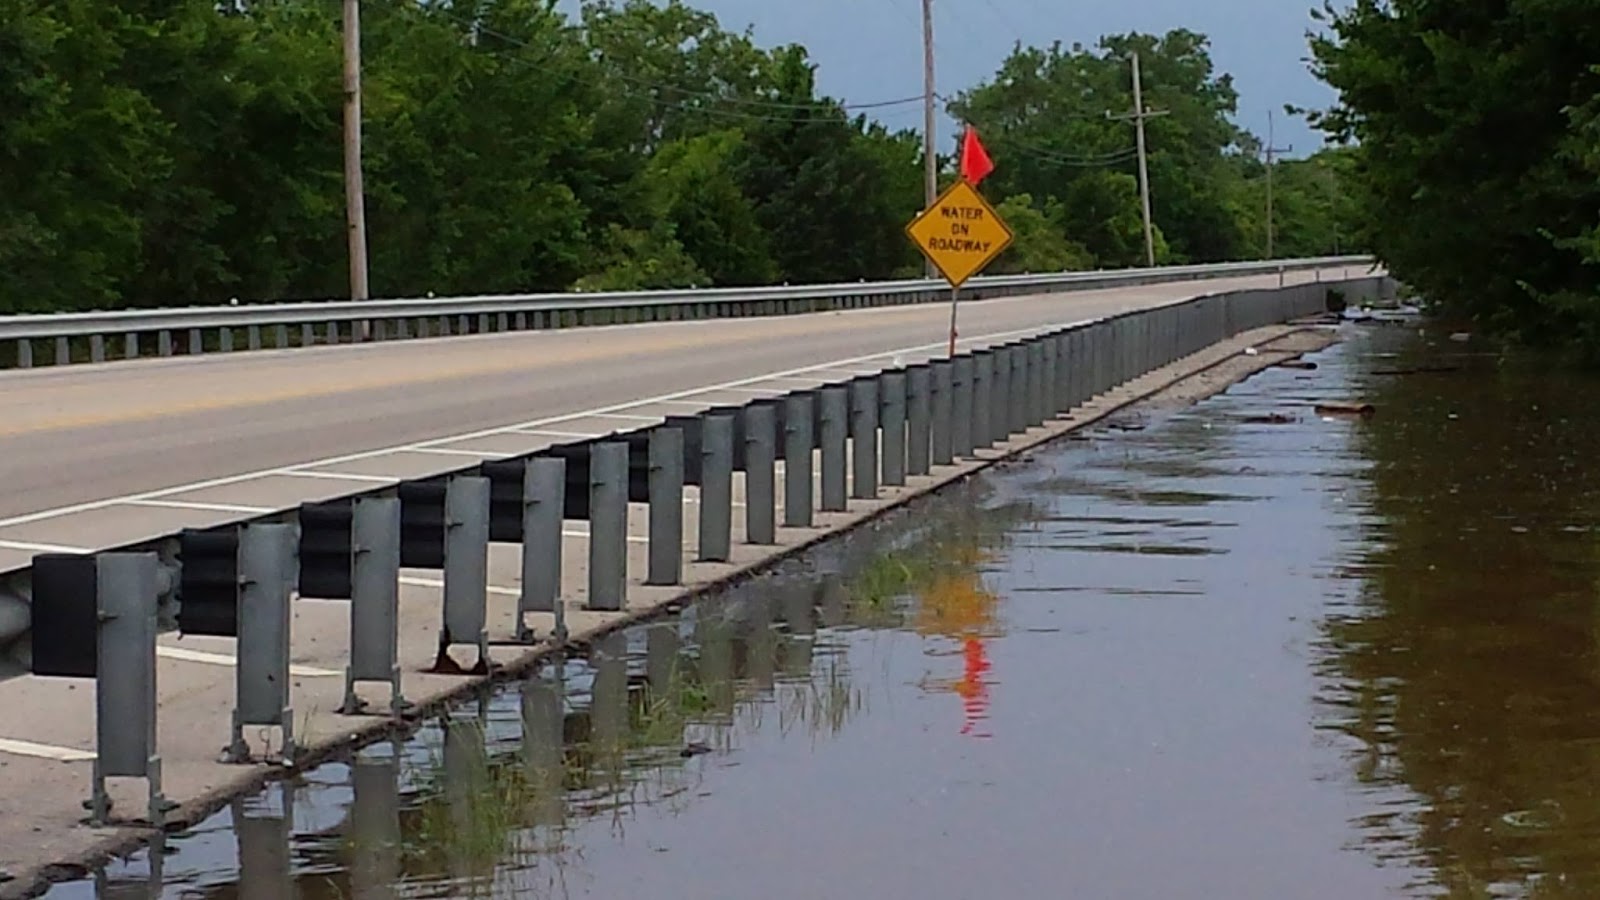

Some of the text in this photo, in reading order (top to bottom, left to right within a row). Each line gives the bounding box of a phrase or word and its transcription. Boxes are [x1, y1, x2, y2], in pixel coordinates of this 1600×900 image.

[941, 207, 983, 220] WATER
[951, 223, 969, 235] ON
[928, 237, 991, 252] ROADWAY
